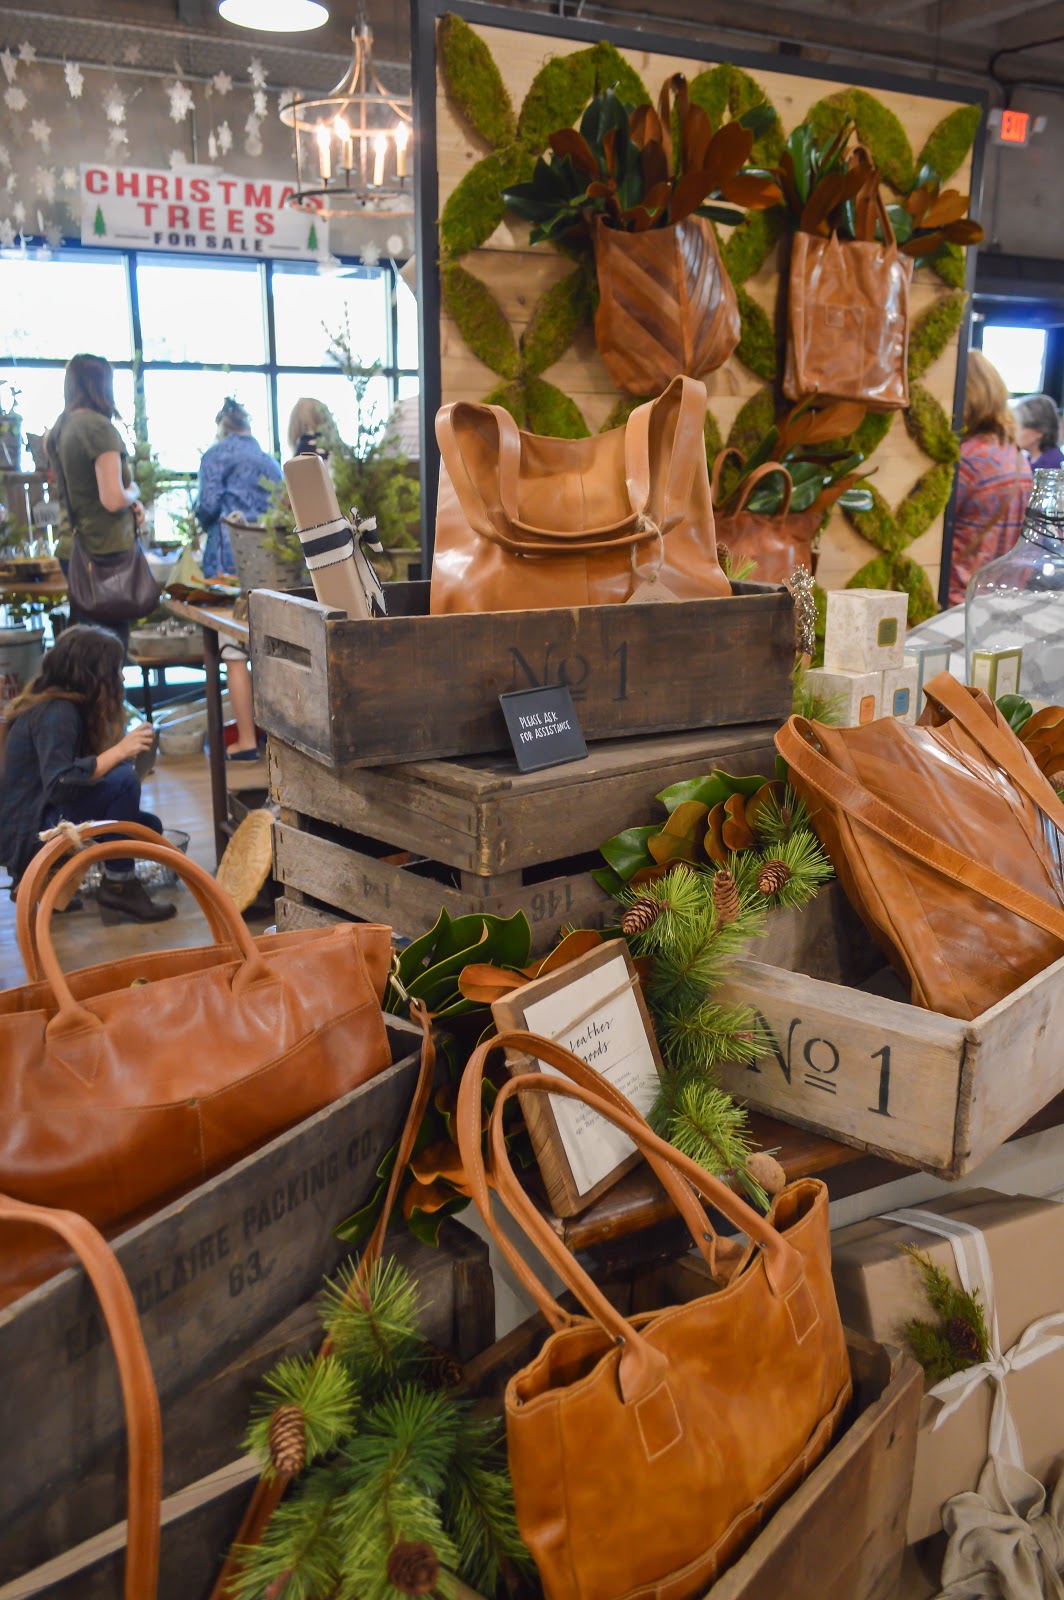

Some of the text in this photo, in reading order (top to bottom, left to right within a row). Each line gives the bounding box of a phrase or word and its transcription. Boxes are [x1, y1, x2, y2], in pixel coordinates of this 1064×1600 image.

[136, 202, 276, 236] TREES
[153, 231, 264, 252] FOR SALE
[612, 640, 629, 701] 1
[519, 711, 558, 729] PLEASE ASK
[520, 720, 571, 744] FOR ASSISTANCE
[568, 1017, 614, 1054] Leather
[867, 1045, 896, 1119] 1
[242, 1152, 340, 1241] PACKING
